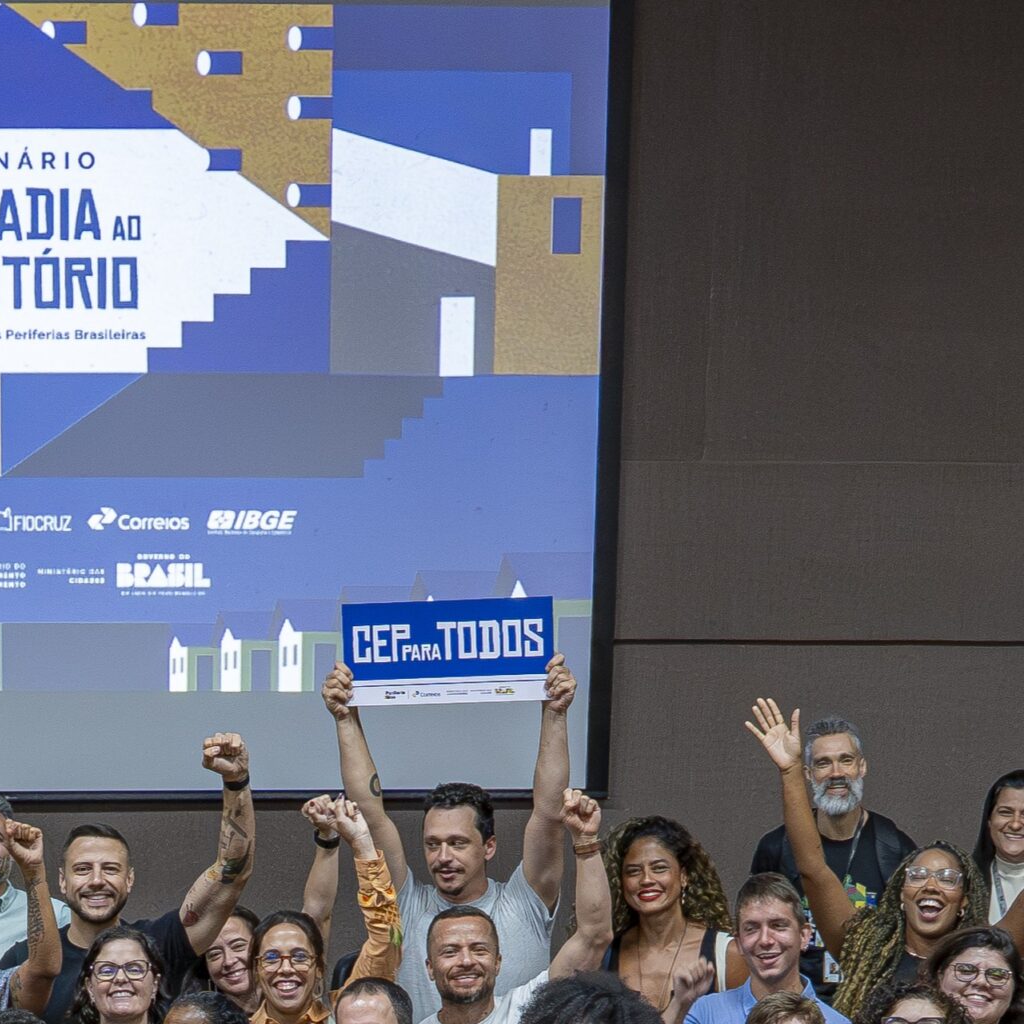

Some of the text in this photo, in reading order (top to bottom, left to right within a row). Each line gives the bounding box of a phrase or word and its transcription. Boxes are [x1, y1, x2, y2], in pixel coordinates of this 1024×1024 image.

[112, 215, 142, 241] AO
[5, 328, 70, 340] Periferias
[74, 328, 146, 340] Brasileiras
[13, 515, 72, 532] FIOCRUZ
[117, 513, 190, 531] Correios
[233, 510, 298, 530] IBGE
[116, 562, 211, 588] BRASIL
[352, 618, 544, 664] CEP PARA TODOS
